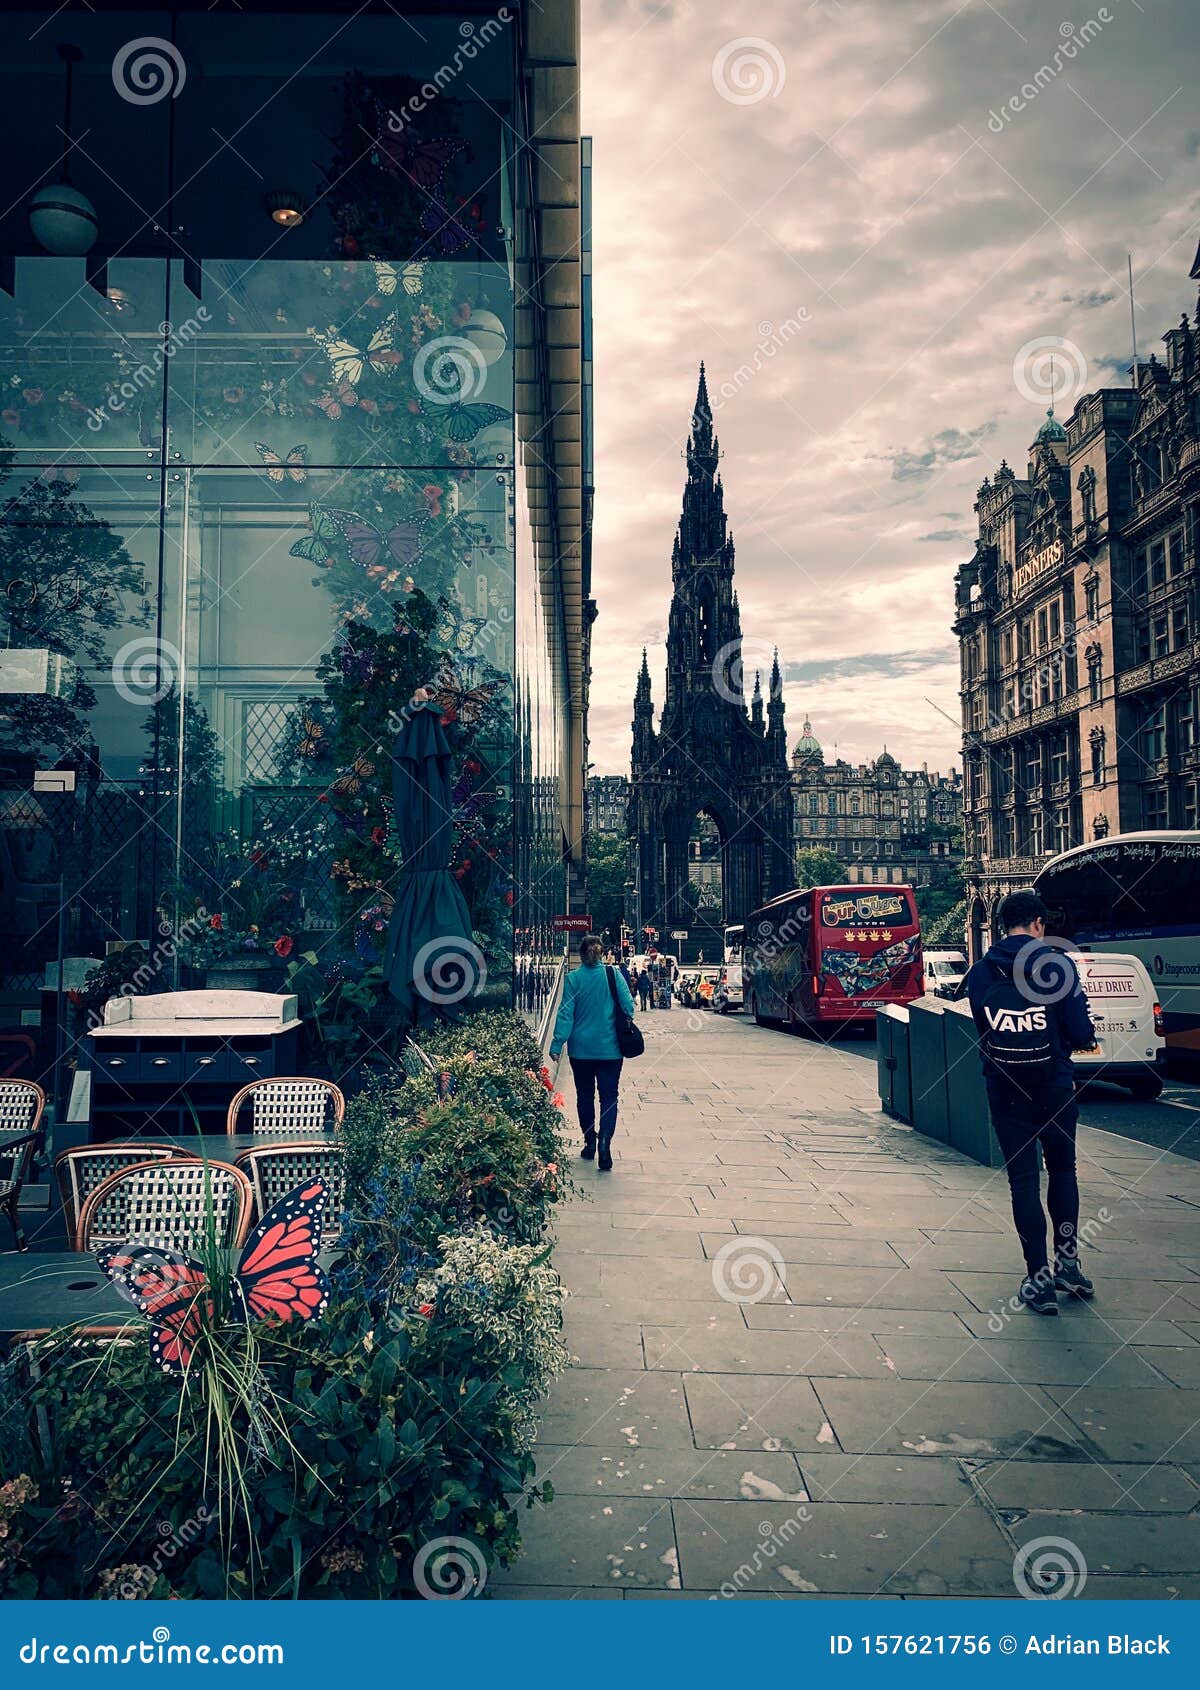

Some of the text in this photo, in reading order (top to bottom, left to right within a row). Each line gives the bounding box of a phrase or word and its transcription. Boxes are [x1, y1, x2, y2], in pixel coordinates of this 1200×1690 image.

[1012, 539, 1062, 598] JENNERS
[1082, 981, 1133, 992] SELF DRIVE
[984, 1006, 1047, 1032] VANS
